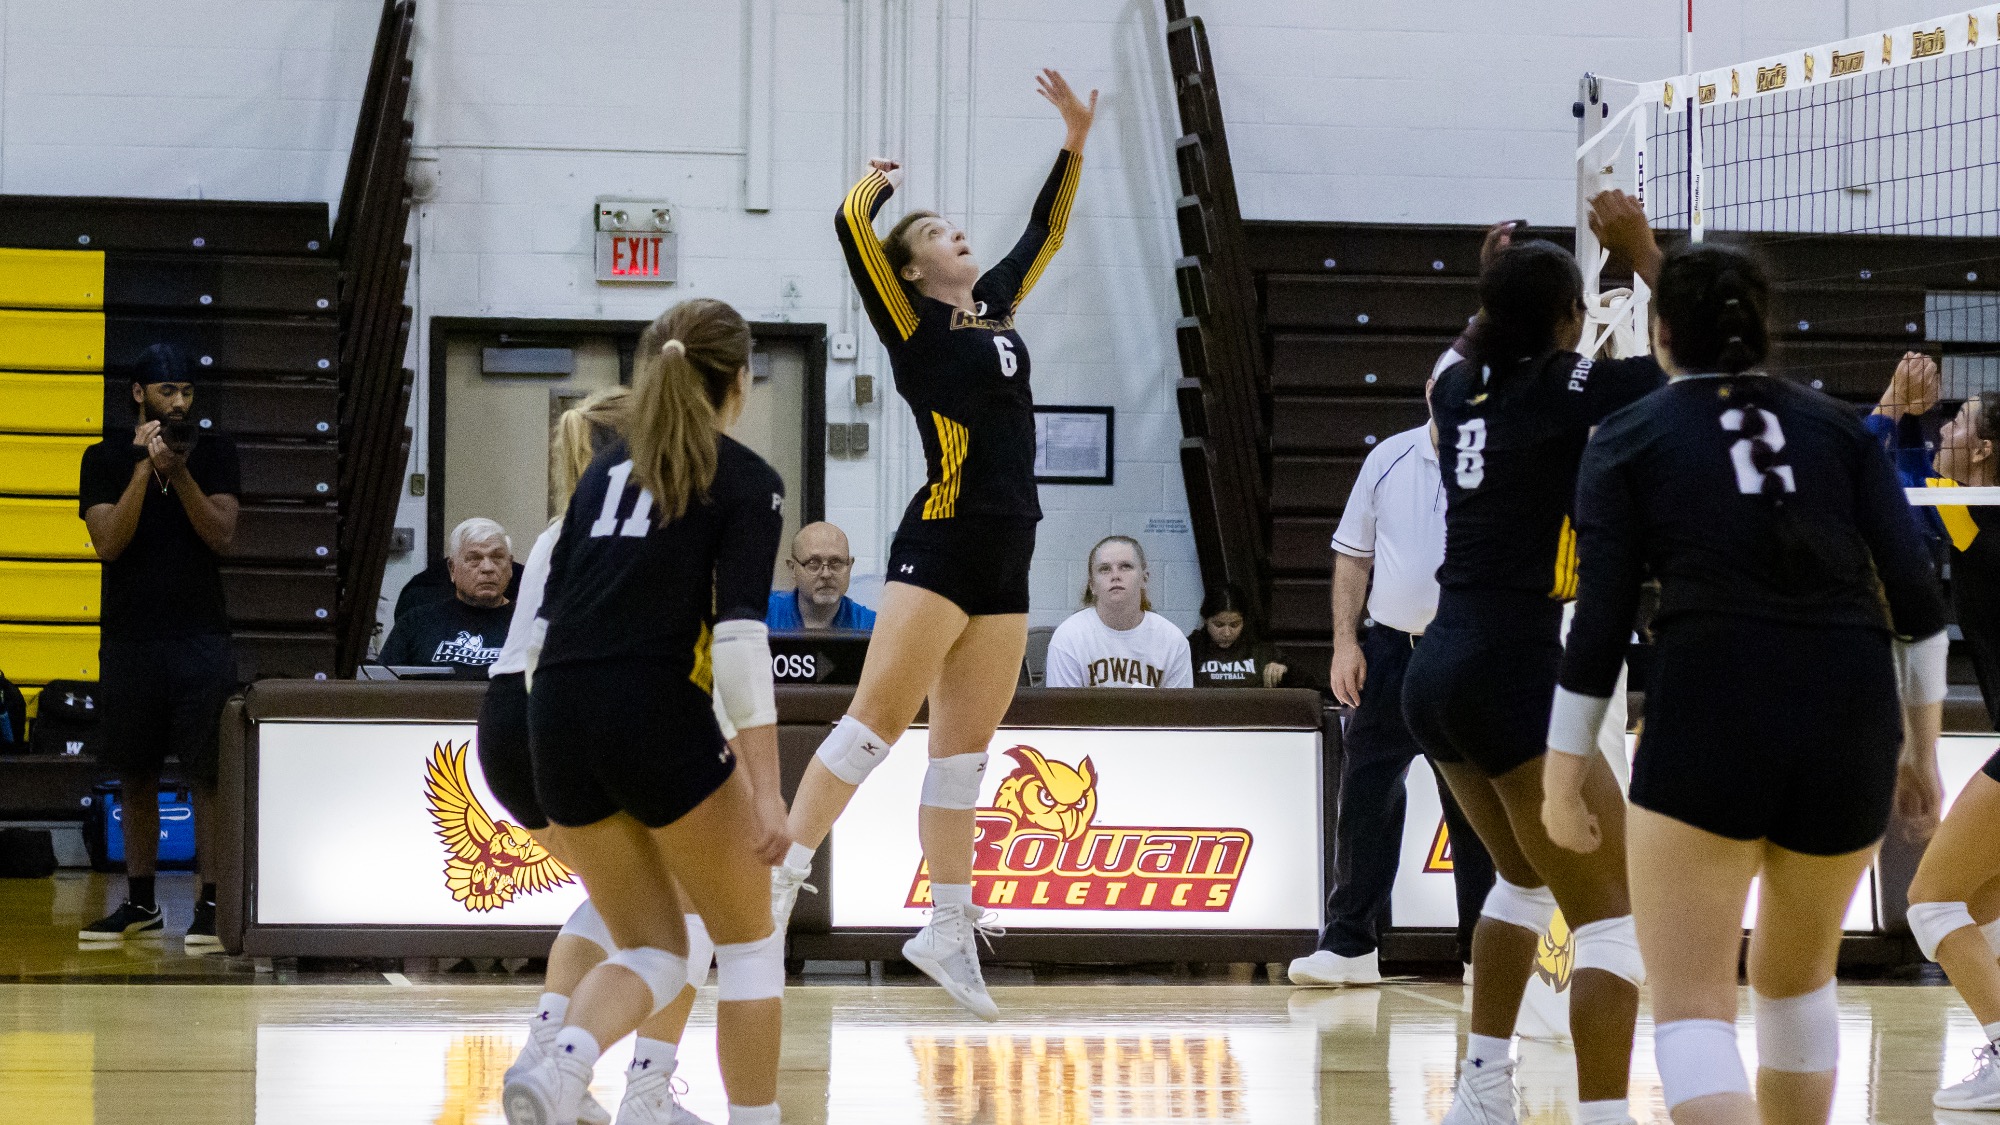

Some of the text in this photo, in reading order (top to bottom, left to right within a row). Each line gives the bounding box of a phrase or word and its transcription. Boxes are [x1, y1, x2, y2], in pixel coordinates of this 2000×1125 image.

[612, 237, 663, 276] EXIT
[993, 335, 1018, 377] 6
[1455, 418, 1487, 489] 8
[1720, 408, 1796, 494] 2
[590, 459, 653, 538] 11
[773, 654, 815, 678] OSS
[912, 881, 1231, 907] AHLETICS
